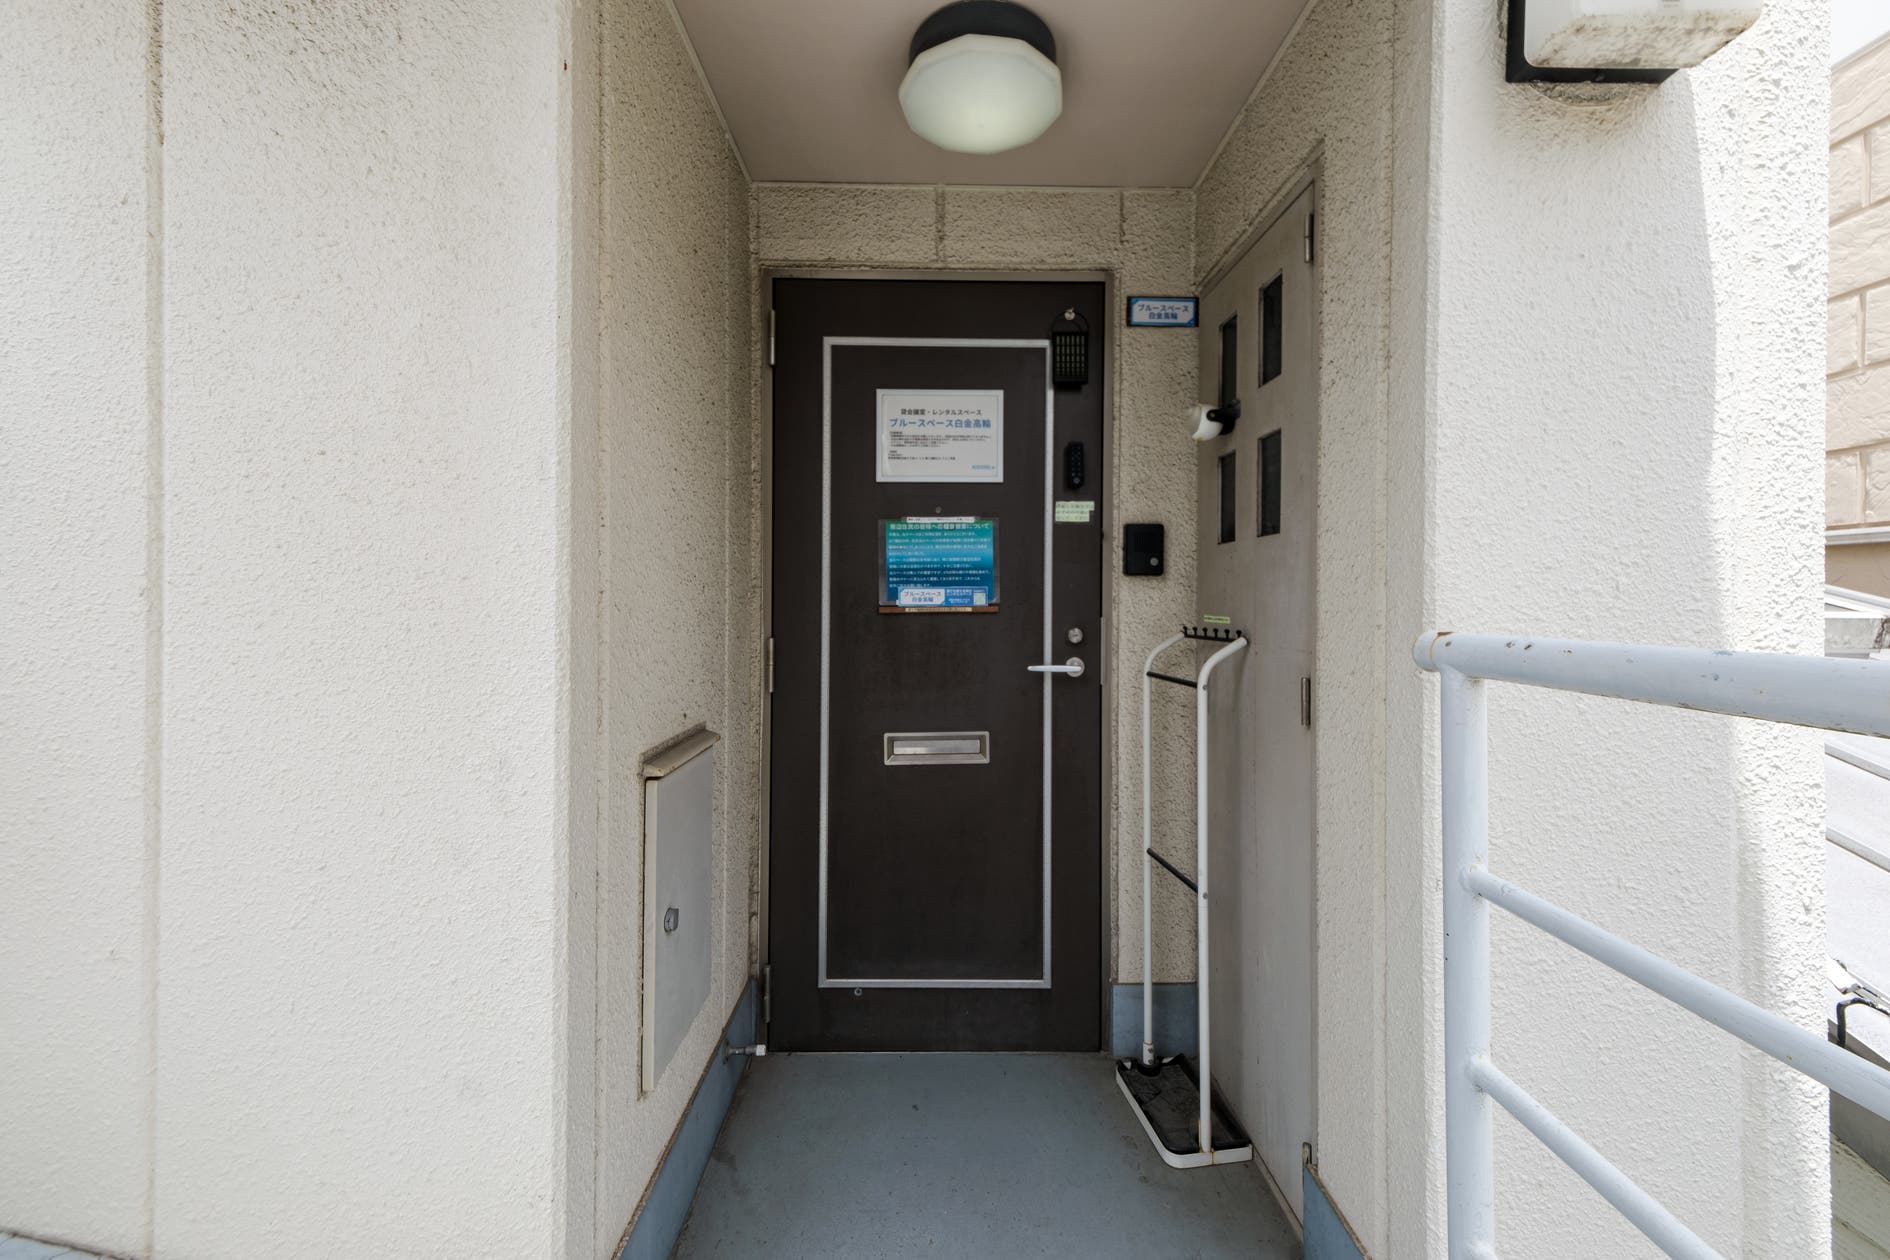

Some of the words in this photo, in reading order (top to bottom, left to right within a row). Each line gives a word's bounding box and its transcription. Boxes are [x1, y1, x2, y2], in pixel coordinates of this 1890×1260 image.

[889, 418, 991, 429] ブルースペース白金高輪
